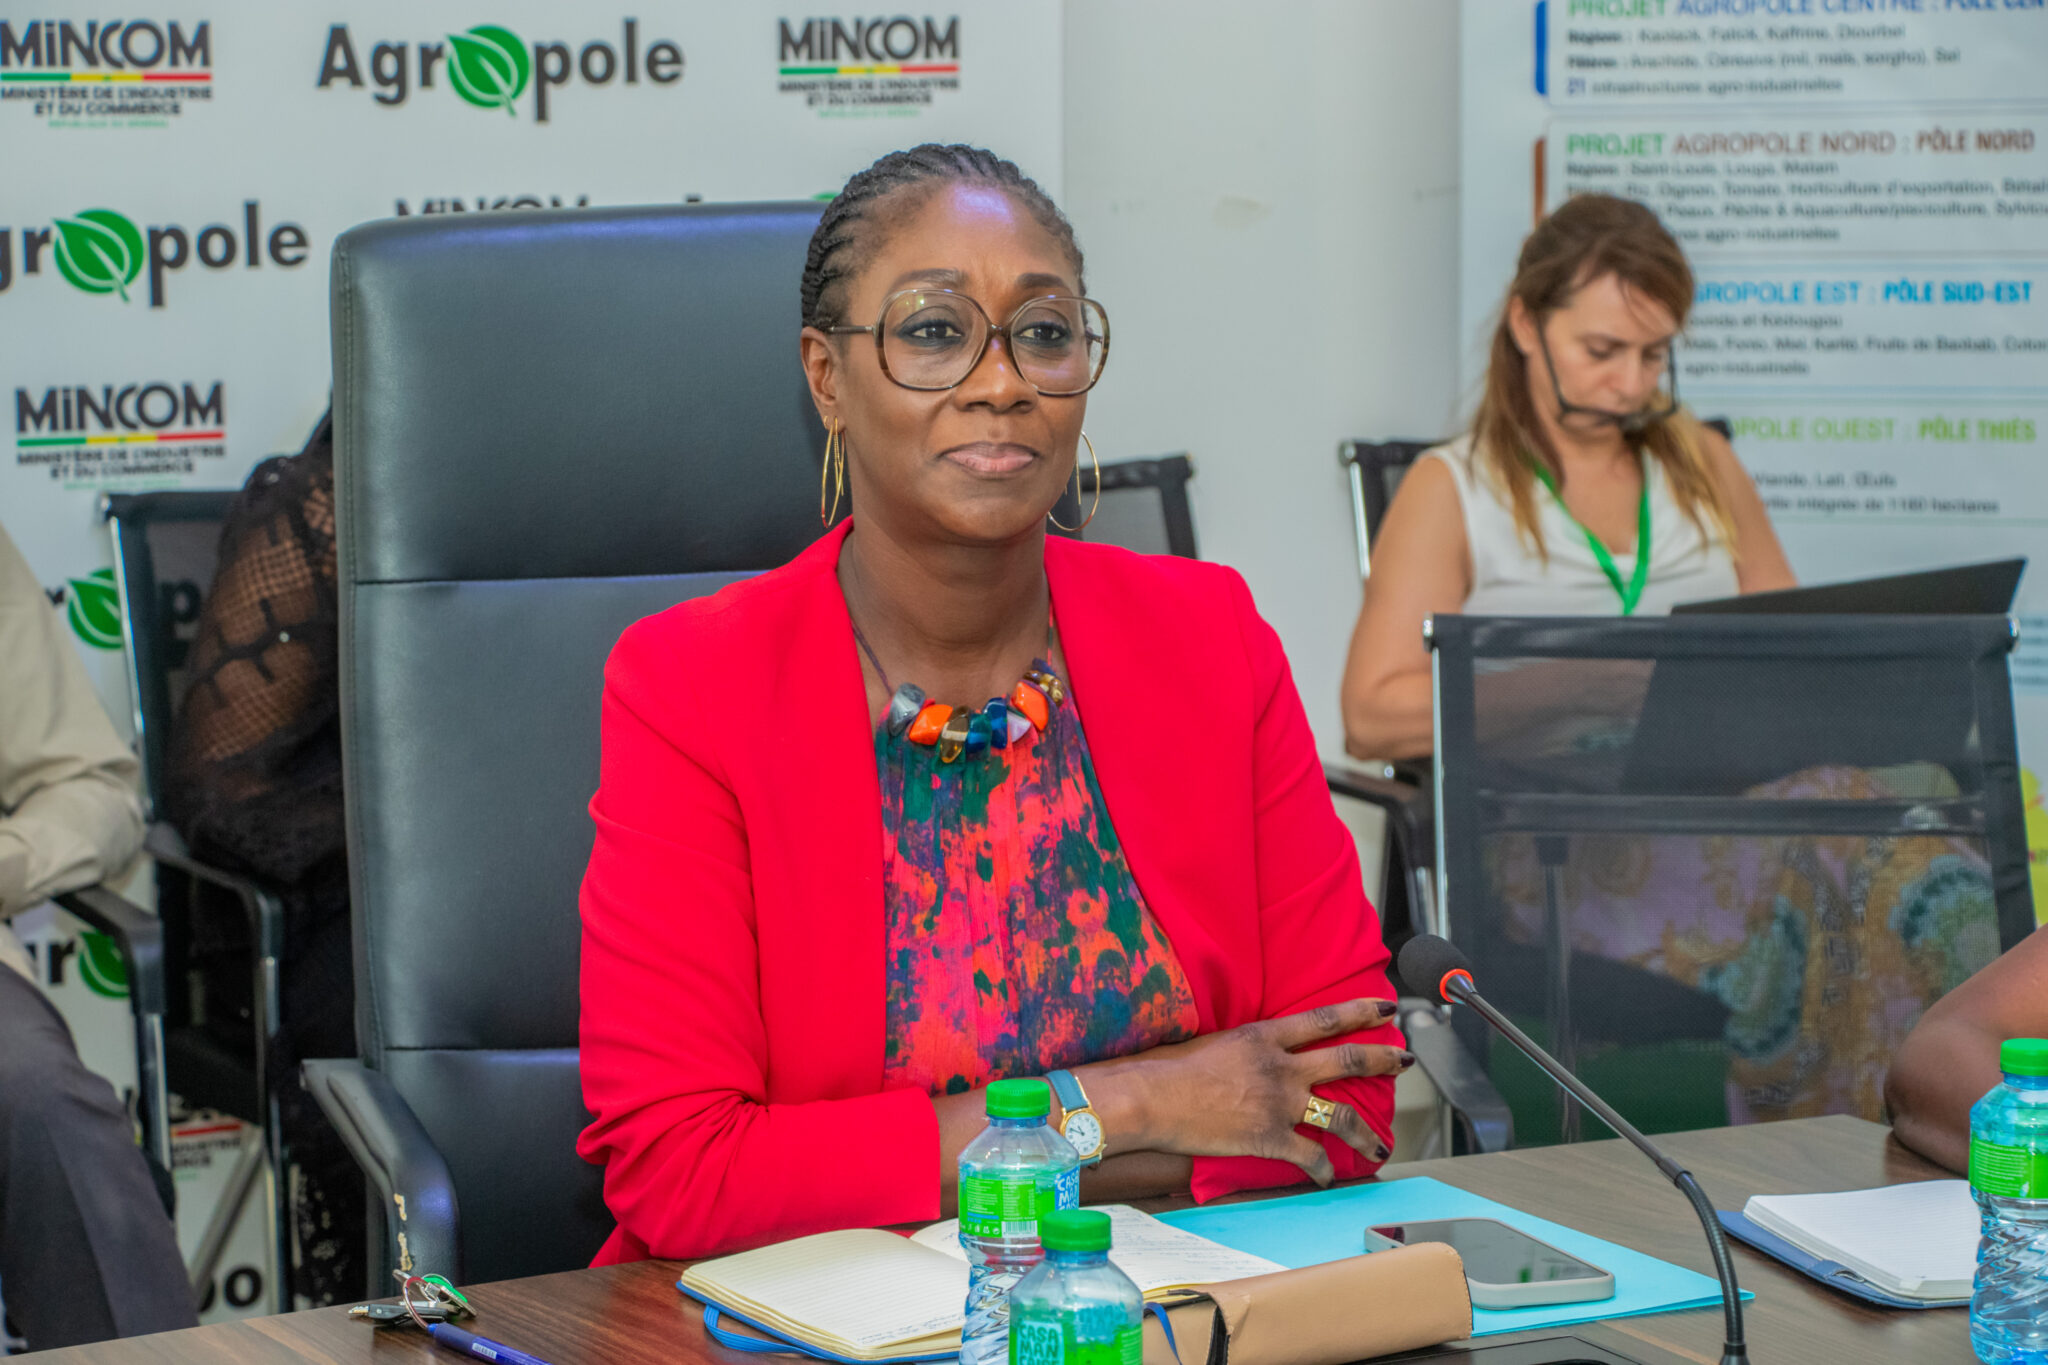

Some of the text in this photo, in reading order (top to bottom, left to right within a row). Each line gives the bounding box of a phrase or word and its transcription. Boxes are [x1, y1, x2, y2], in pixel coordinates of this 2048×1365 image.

[93, 86, 113, 99] DE
[35, 102, 181, 116] ET DU COMMERCE
[1567, 133, 1666, 156] PROJET
[1672, 131, 1813, 156] AGROPOLE
[1820, 131, 1896, 156] NORD
[1975, 129, 2036, 154] NORD
[1814, 280, 1860, 304] EST
[1942, 280, 2032, 304] SUD-EST
[1812, 417, 1896, 441] OUEST
